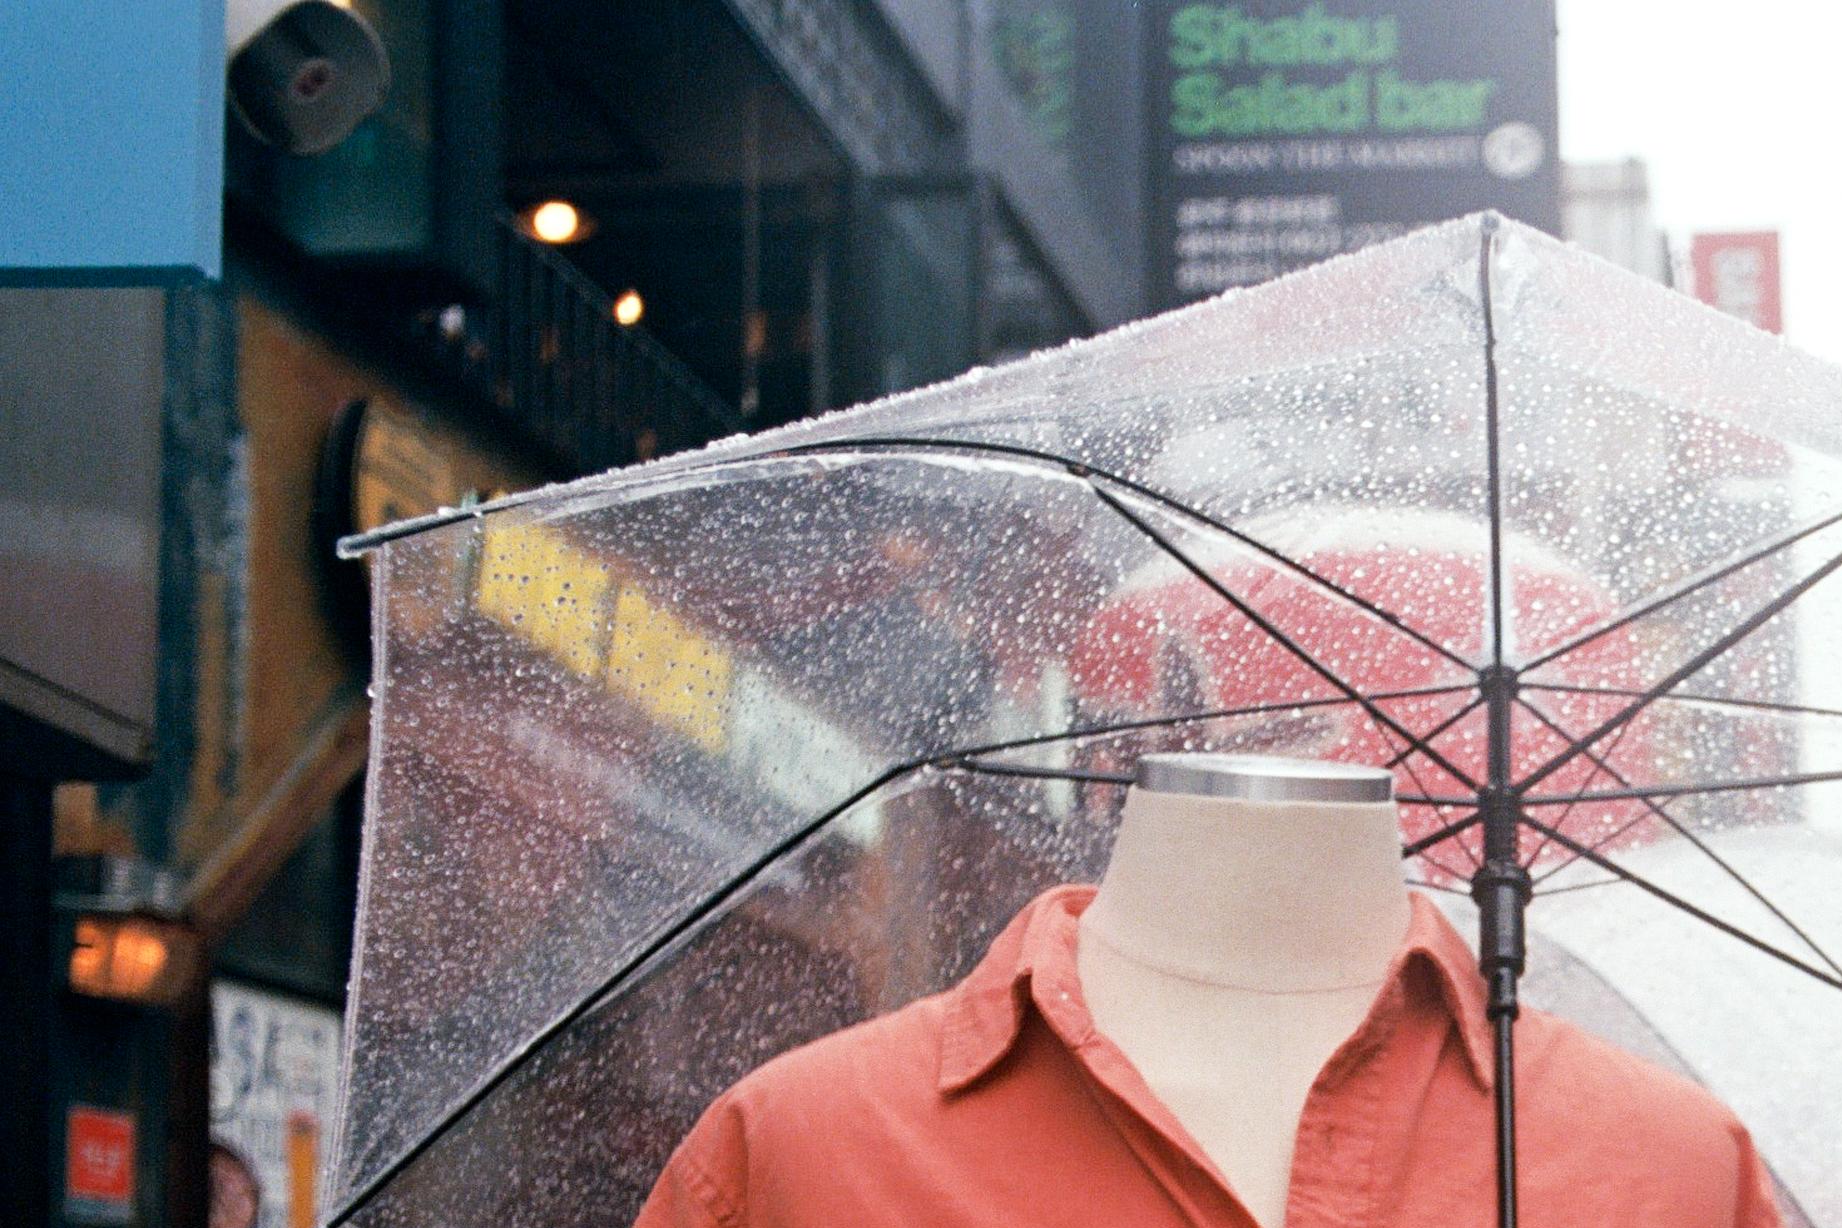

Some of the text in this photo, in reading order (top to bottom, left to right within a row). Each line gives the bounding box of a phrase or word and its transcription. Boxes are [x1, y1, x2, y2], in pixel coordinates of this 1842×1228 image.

[1170, 3, 1398, 66] Shabu
[1170, 69, 1495, 136] Salad bar
